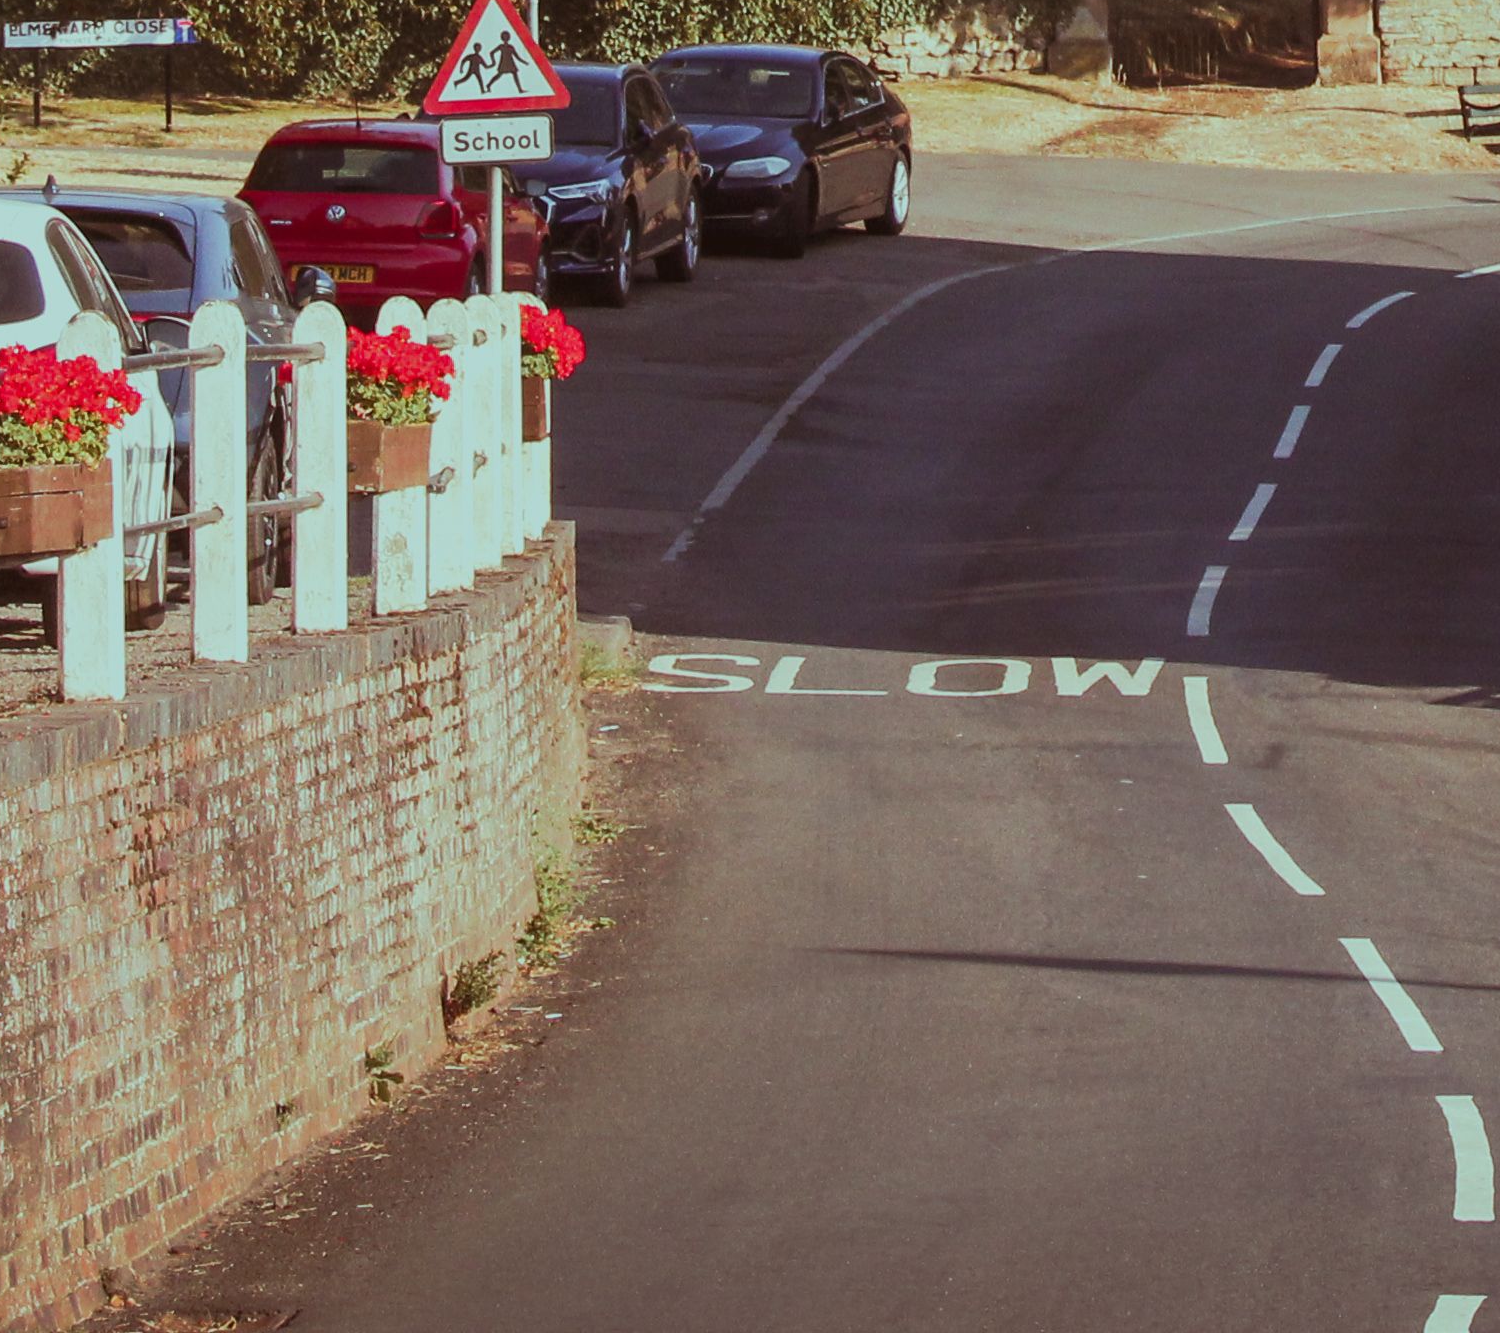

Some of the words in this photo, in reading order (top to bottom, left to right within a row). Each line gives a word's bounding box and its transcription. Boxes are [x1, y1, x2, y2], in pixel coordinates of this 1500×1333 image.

[113, 20, 168, 34] CLOSE
[453, 129, 540, 152] School
[640, 654, 1165, 698] SLOW
